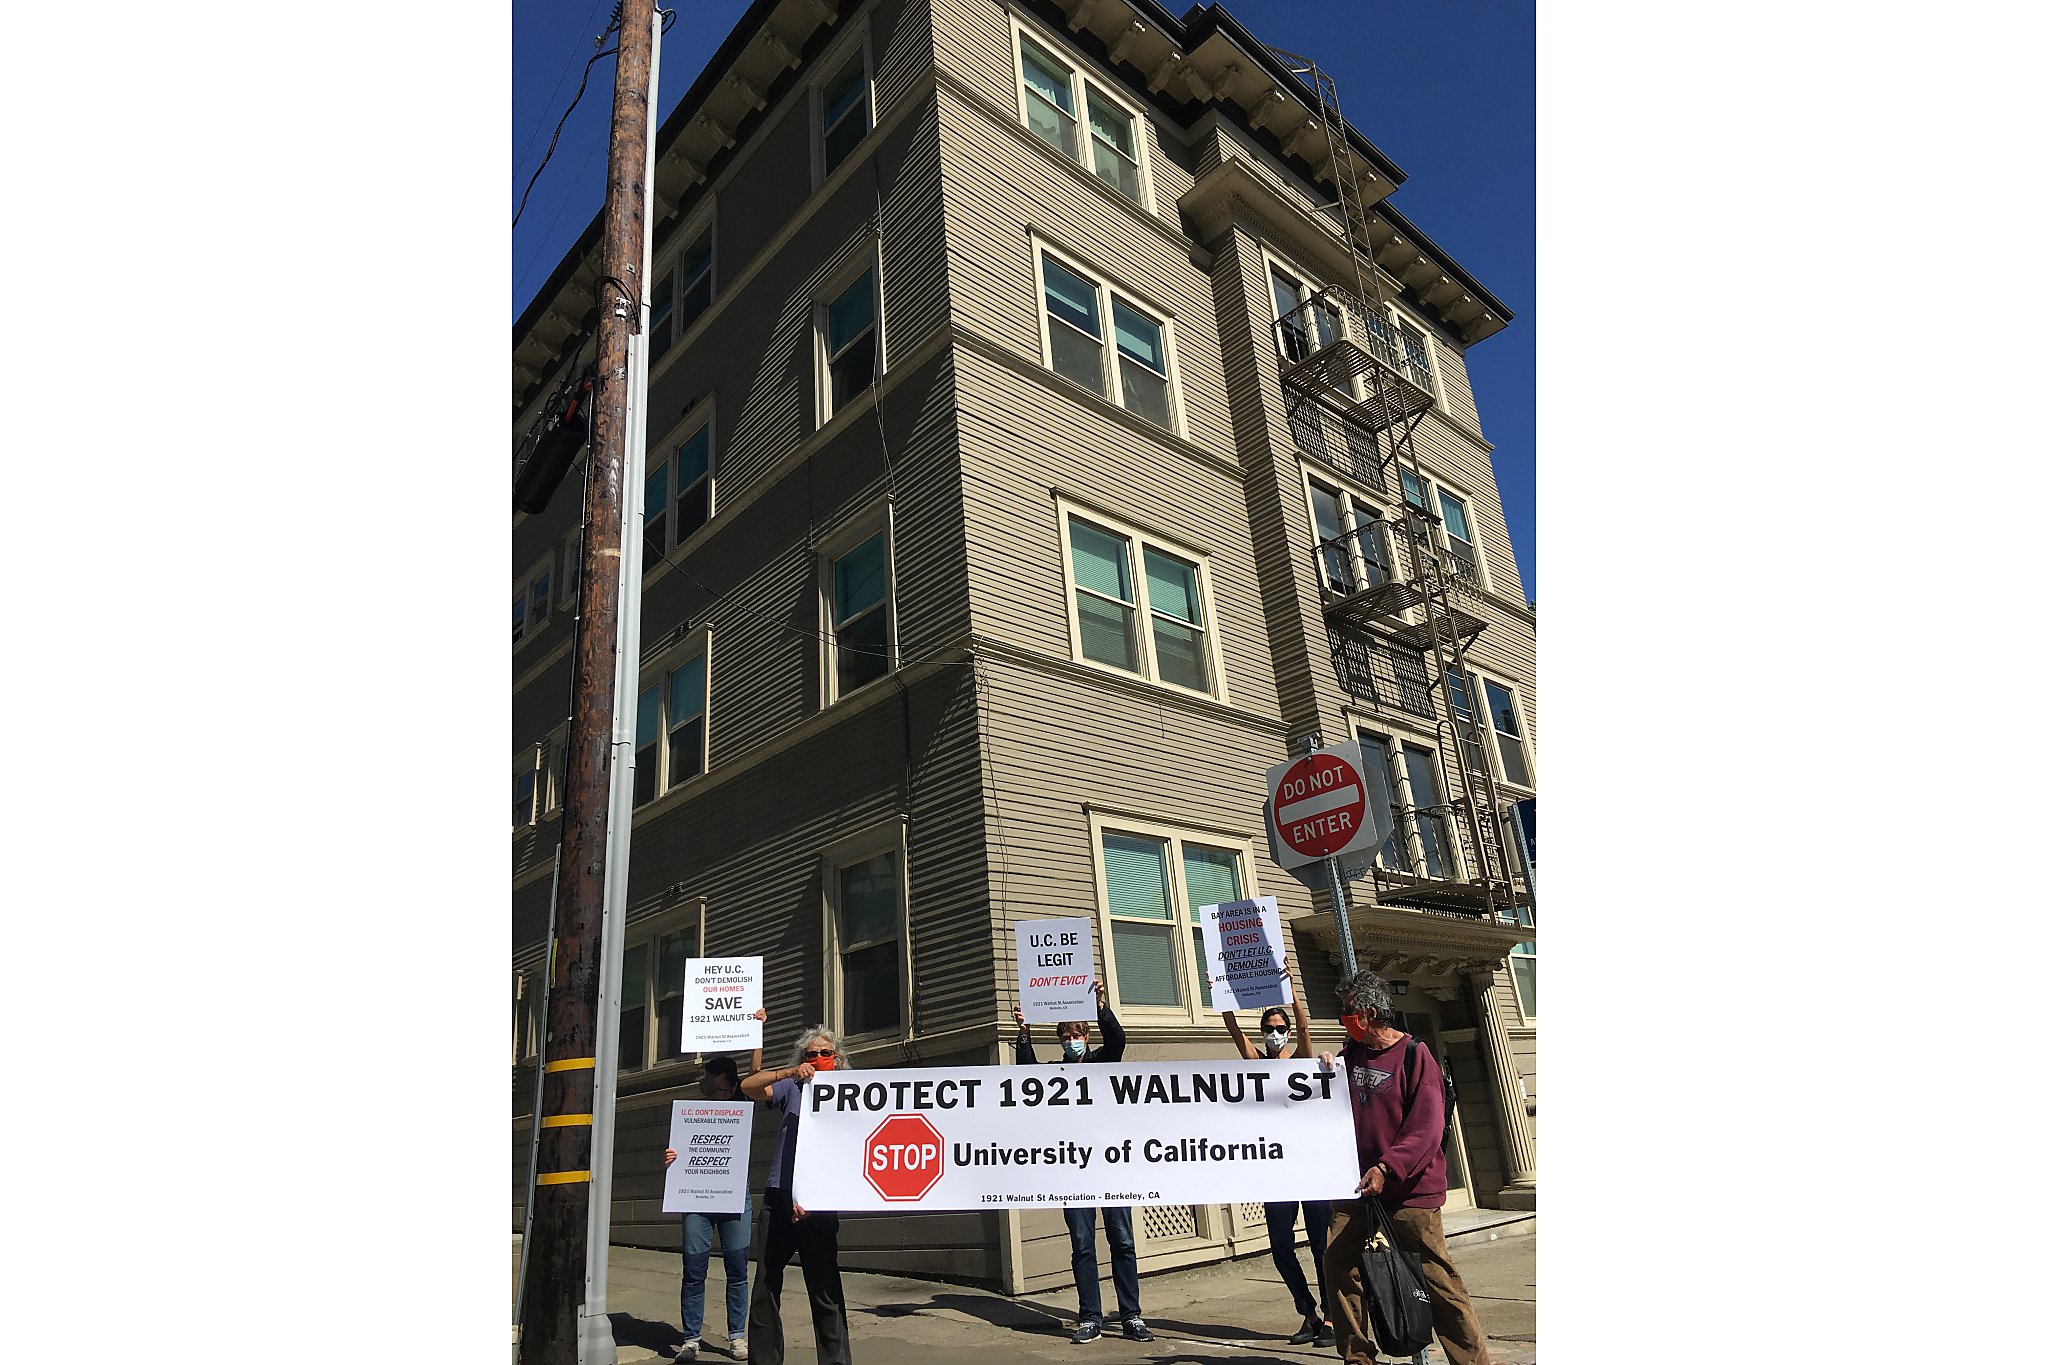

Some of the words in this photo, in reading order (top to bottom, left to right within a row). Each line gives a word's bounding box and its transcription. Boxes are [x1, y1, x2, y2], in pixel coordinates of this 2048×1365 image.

[1283, 778, 1305, 800] DO
[1309, 765, 1343, 792] NOT
[1292, 811, 1353, 844] ENTER
[1211, 911, 1225, 920] BAY
[1225, 908, 1243, 918] AREA
[1244, 907, 1252, 915] IS
[1253, 906, 1260, 914] IN
[1262, 905, 1267, 913] A
[1218, 917, 1263, 933] HOUSING
[1030, 934, 1056, 948] U.C.
[1060, 932, 1078, 946] BE
[1226, 933, 1260, 946] CRISIS
[1037, 952, 1073, 967] LEGIT
[1218, 949, 1243, 961] DON'T
[1243, 947, 1258, 957] LET
[1257, 945, 1274, 955] U.C.
[704, 965, 722, 974] HEY
[724, 964, 744, 974] U.C.
[1227, 958, 1269, 972] DEMOLISH
[717, 976, 753, 984] DEMOLISH
[1029, 976, 1060, 988] DON'T
[1060, 975, 1088, 986] EVICT
[1215, 972, 1254, 982] AFFORDABLE
[1254, 967, 1283, 978] HOUSING
[704, 997, 743, 1010] SAVE
[690, 1015, 711, 1023] 1921
[712, 1014, 745, 1022] WALNUT
[811, 1079, 982, 1112] PROTECT
[999, 1076, 1094, 1107] 1921
[1109, 1072, 1270, 1105] WALNUT
[1287, 1071, 1336, 1102] ST
[715, 1109, 744, 1117] DISPLACE
[690, 1134, 734, 1145] RESPECT
[871, 1143, 937, 1171] STOP
[953, 1140, 1093, 1169] University
[1104, 1139, 1132, 1163] of
[1143, 1136, 1284, 1163] California
[688, 1156, 732, 1167] RESPECT
[981, 1194, 1003, 1202] 1921
[1006, 1194, 1034, 1202] Walnut
[1048, 1193, 1096, 1201] Association
[1104, 1192, 1145, 1201] Berkeley,
[1148, 1191, 1160, 1199] CA
